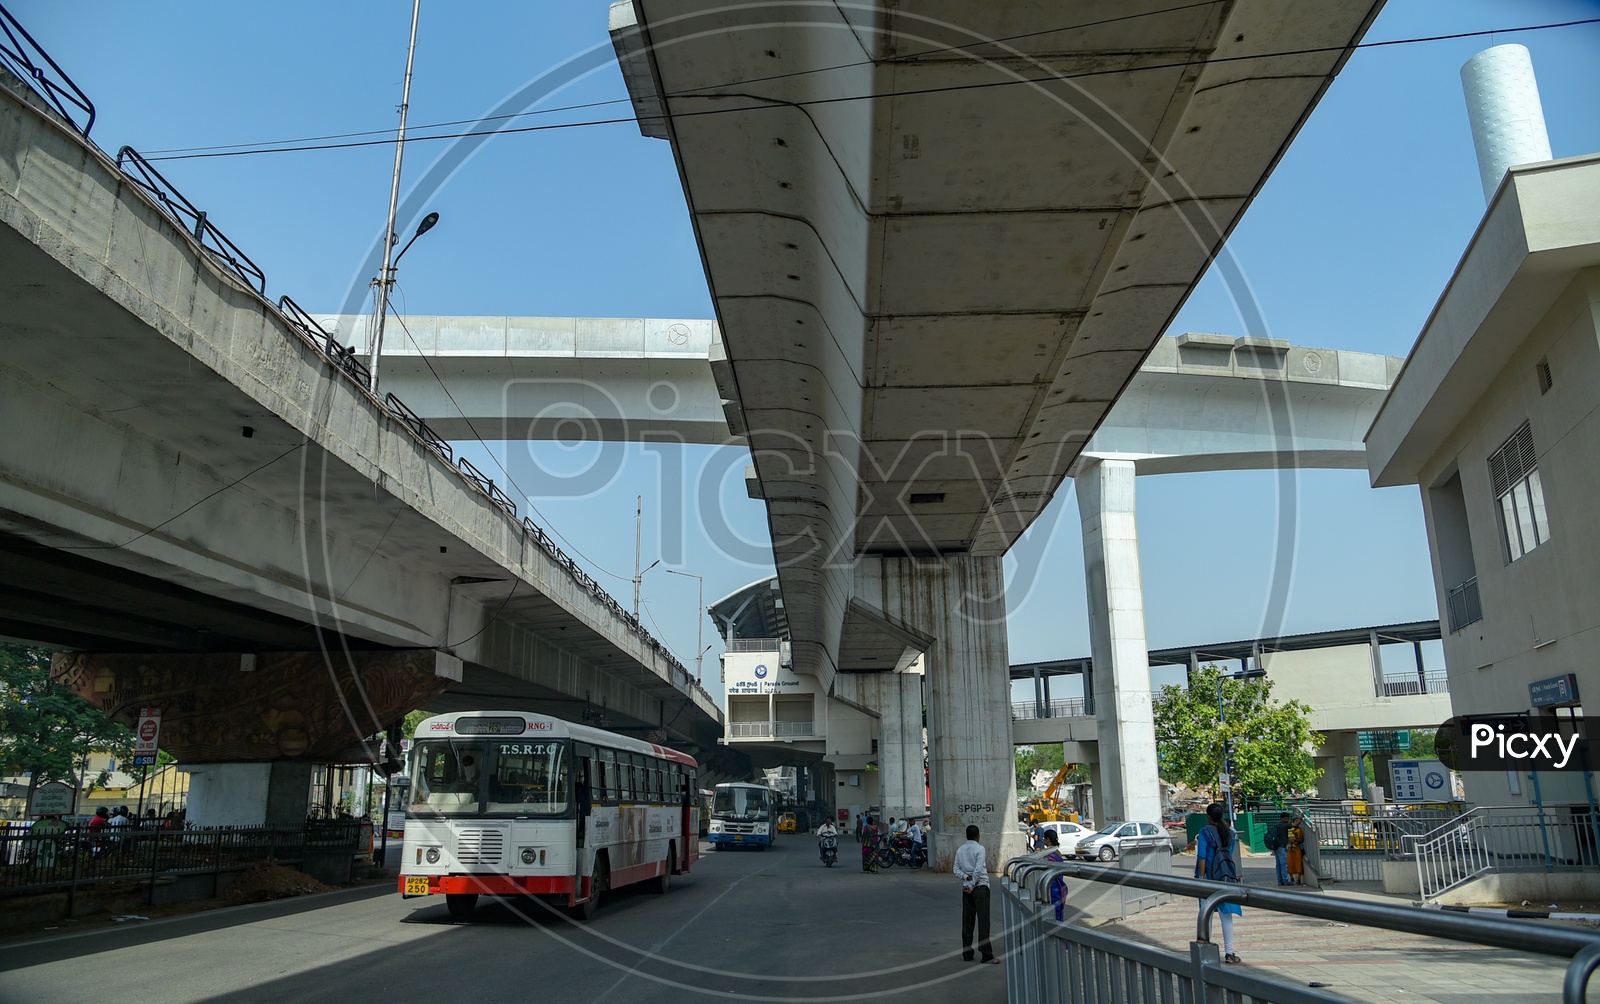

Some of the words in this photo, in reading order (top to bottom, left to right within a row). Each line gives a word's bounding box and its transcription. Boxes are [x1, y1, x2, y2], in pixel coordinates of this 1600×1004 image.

[142, 756, 154, 765] SBI
[958, 803, 994, 813] SPGP-51
[408, 885, 425, 893] 250
